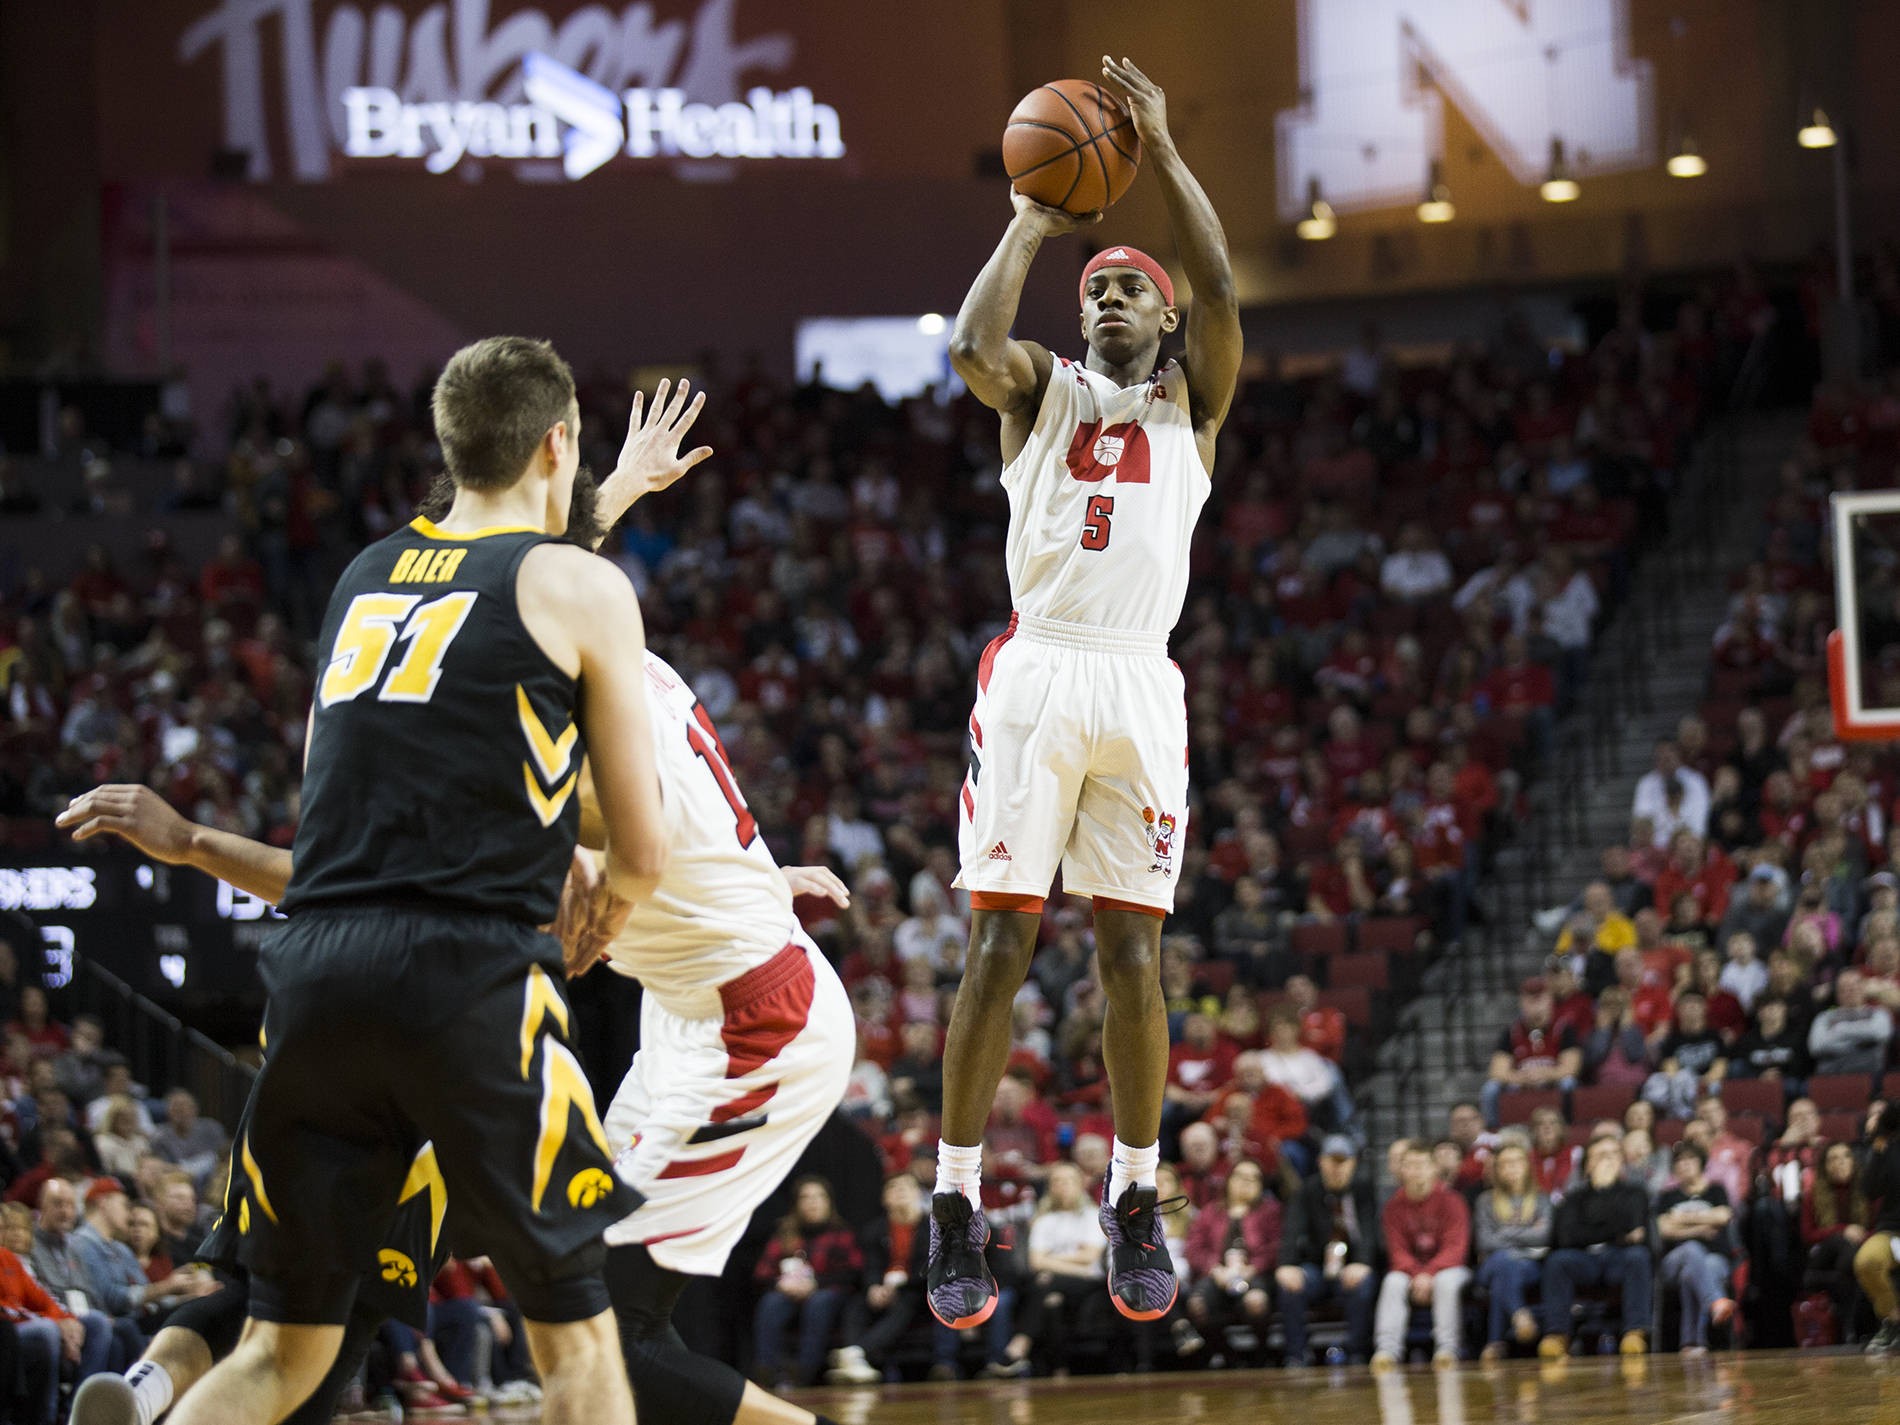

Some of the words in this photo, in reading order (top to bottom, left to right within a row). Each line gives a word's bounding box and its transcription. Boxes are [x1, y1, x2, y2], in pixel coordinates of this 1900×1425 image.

[342, 86, 560, 174] Bryan
[622, 86, 846, 159] Health
[1080, 495, 1114, 551] 5
[388, 548, 468, 583] BAER
[320, 591, 479, 708] 51
